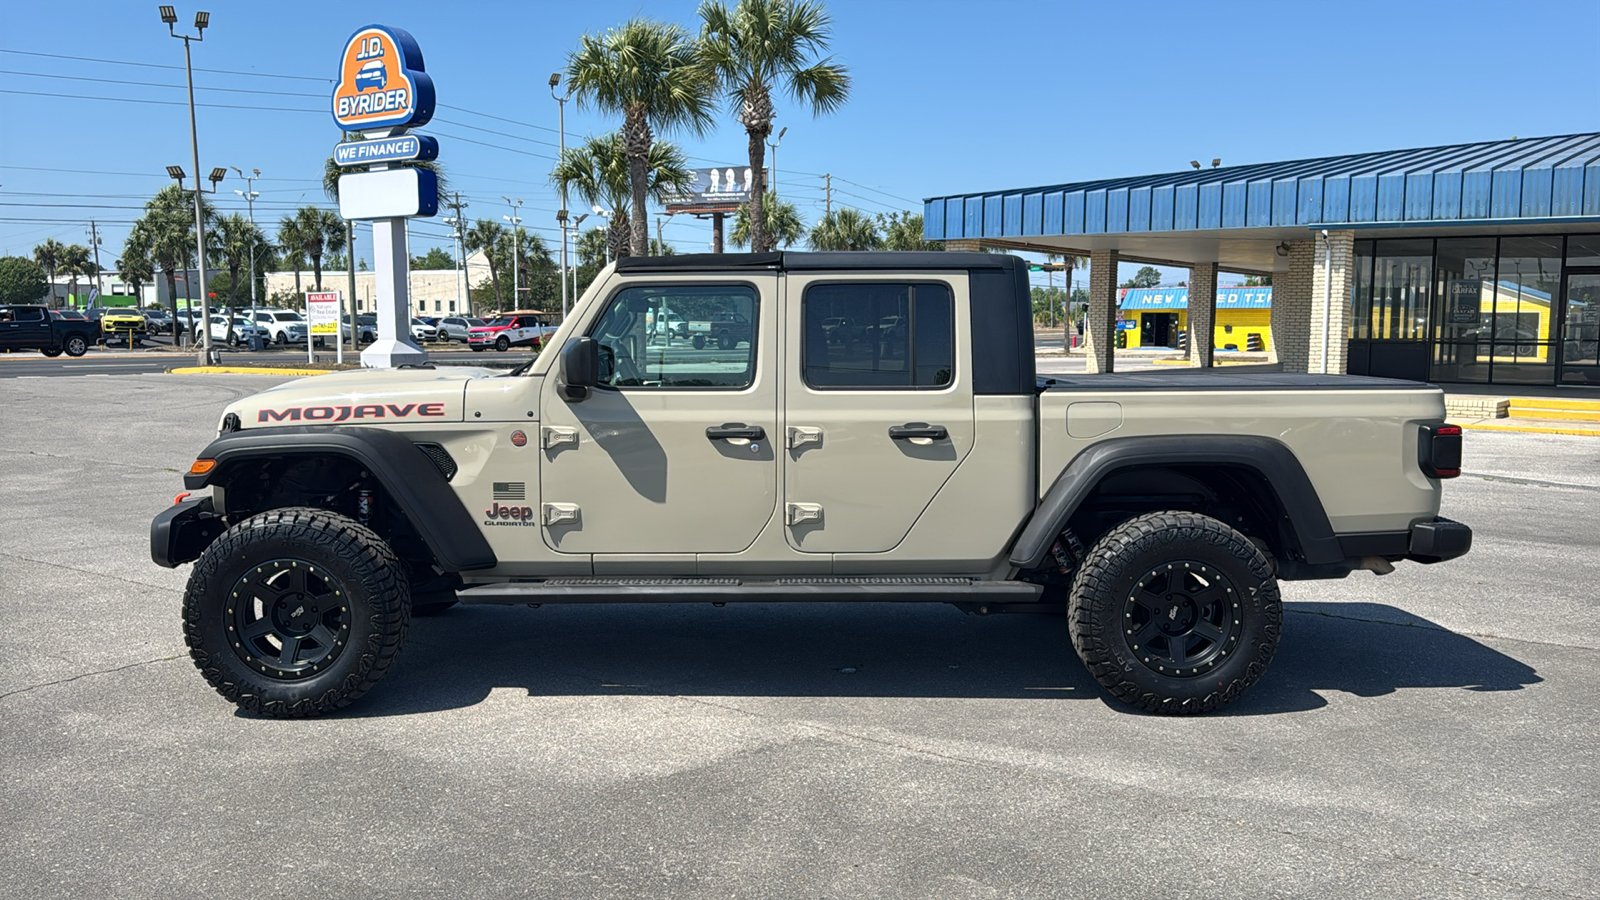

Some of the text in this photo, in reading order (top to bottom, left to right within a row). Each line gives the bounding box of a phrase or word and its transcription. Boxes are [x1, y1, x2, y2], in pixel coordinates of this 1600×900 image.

[357, 36, 384, 60] J.D.
[338, 88, 408, 117] BYRIDER
[338, 141, 414, 160] WE FINANCE!
[1142, 294, 1174, 304] NEW
[1216, 293, 1238, 303] ED
[258, 403, 445, 422] MOJAVE
[485, 501, 533, 522] Jeep
